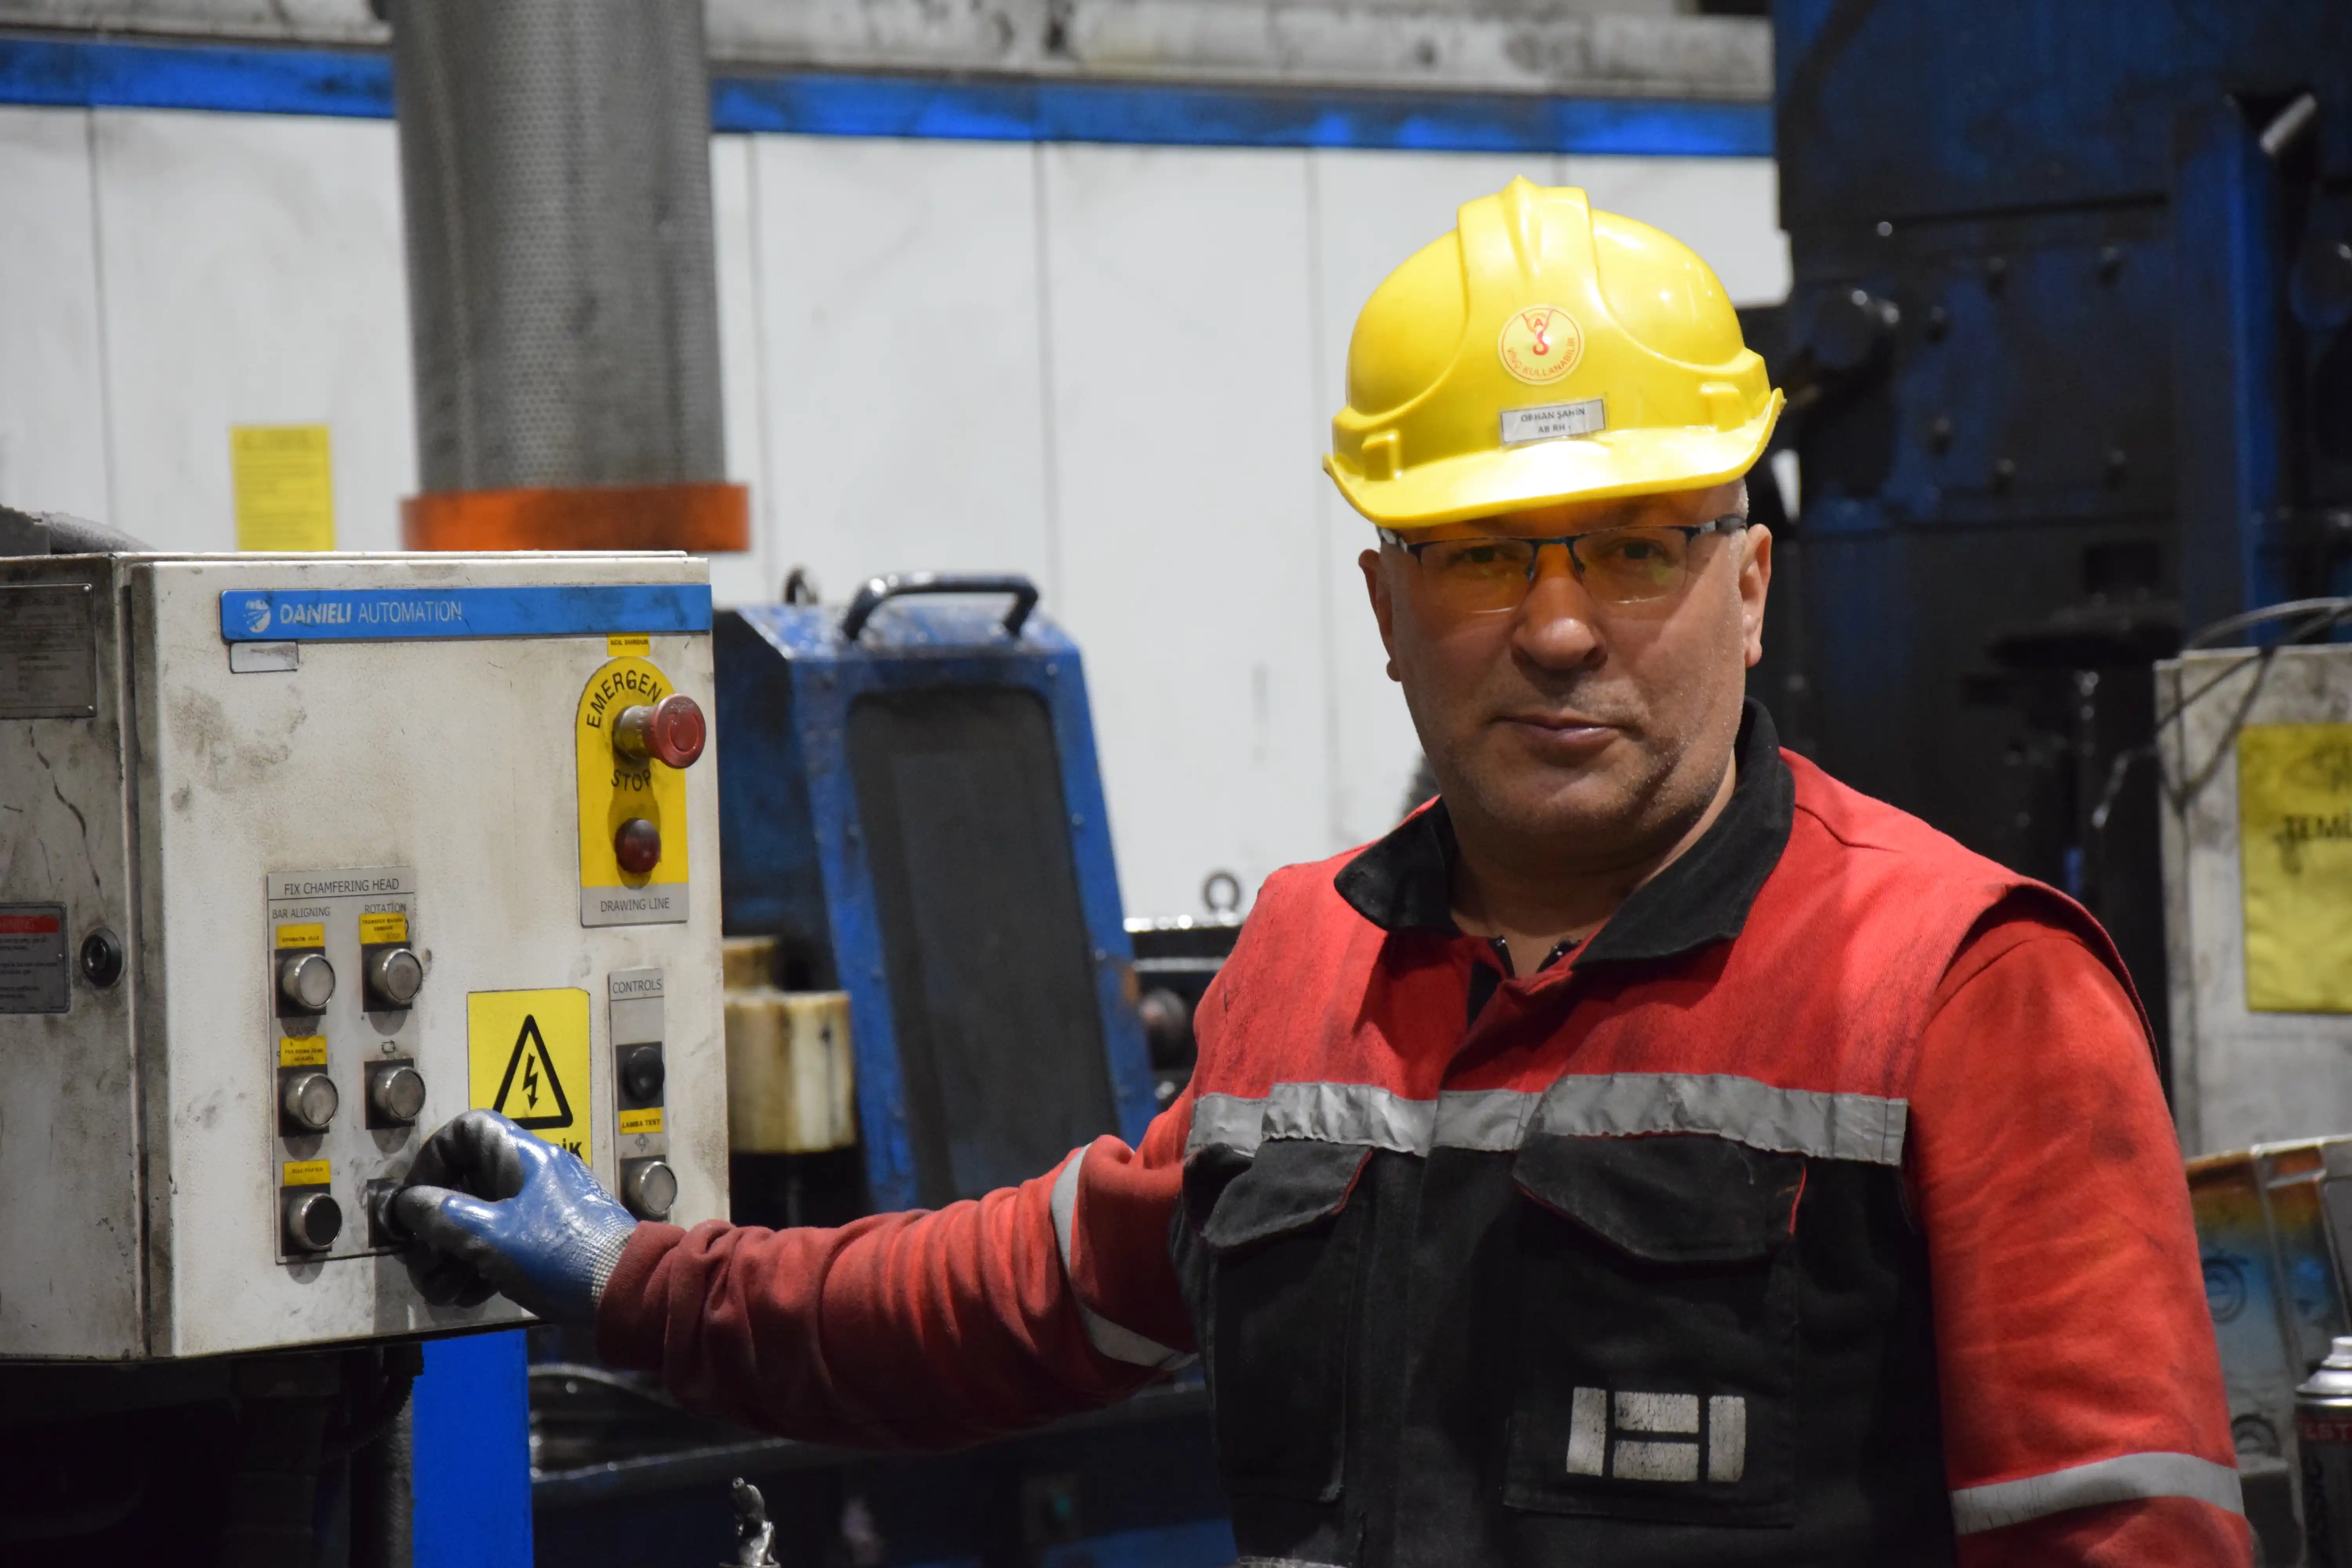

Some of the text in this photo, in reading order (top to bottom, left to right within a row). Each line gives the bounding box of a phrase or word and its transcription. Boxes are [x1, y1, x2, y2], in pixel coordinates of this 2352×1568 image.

[280, 601, 462, 624] DANIELI AUTOMATION
[587, 670, 662, 729] EMERGEN
[611, 769, 651, 791] STOP
[285, 878, 399, 895] FIX CHAMFERING HEAD
[272, 906, 331, 919] BAR ALIGNING
[365, 903, 407, 914] ROTATION
[601, 897, 670, 912] DRAWING LINE
[612, 978, 662, 994] CONTROLS
